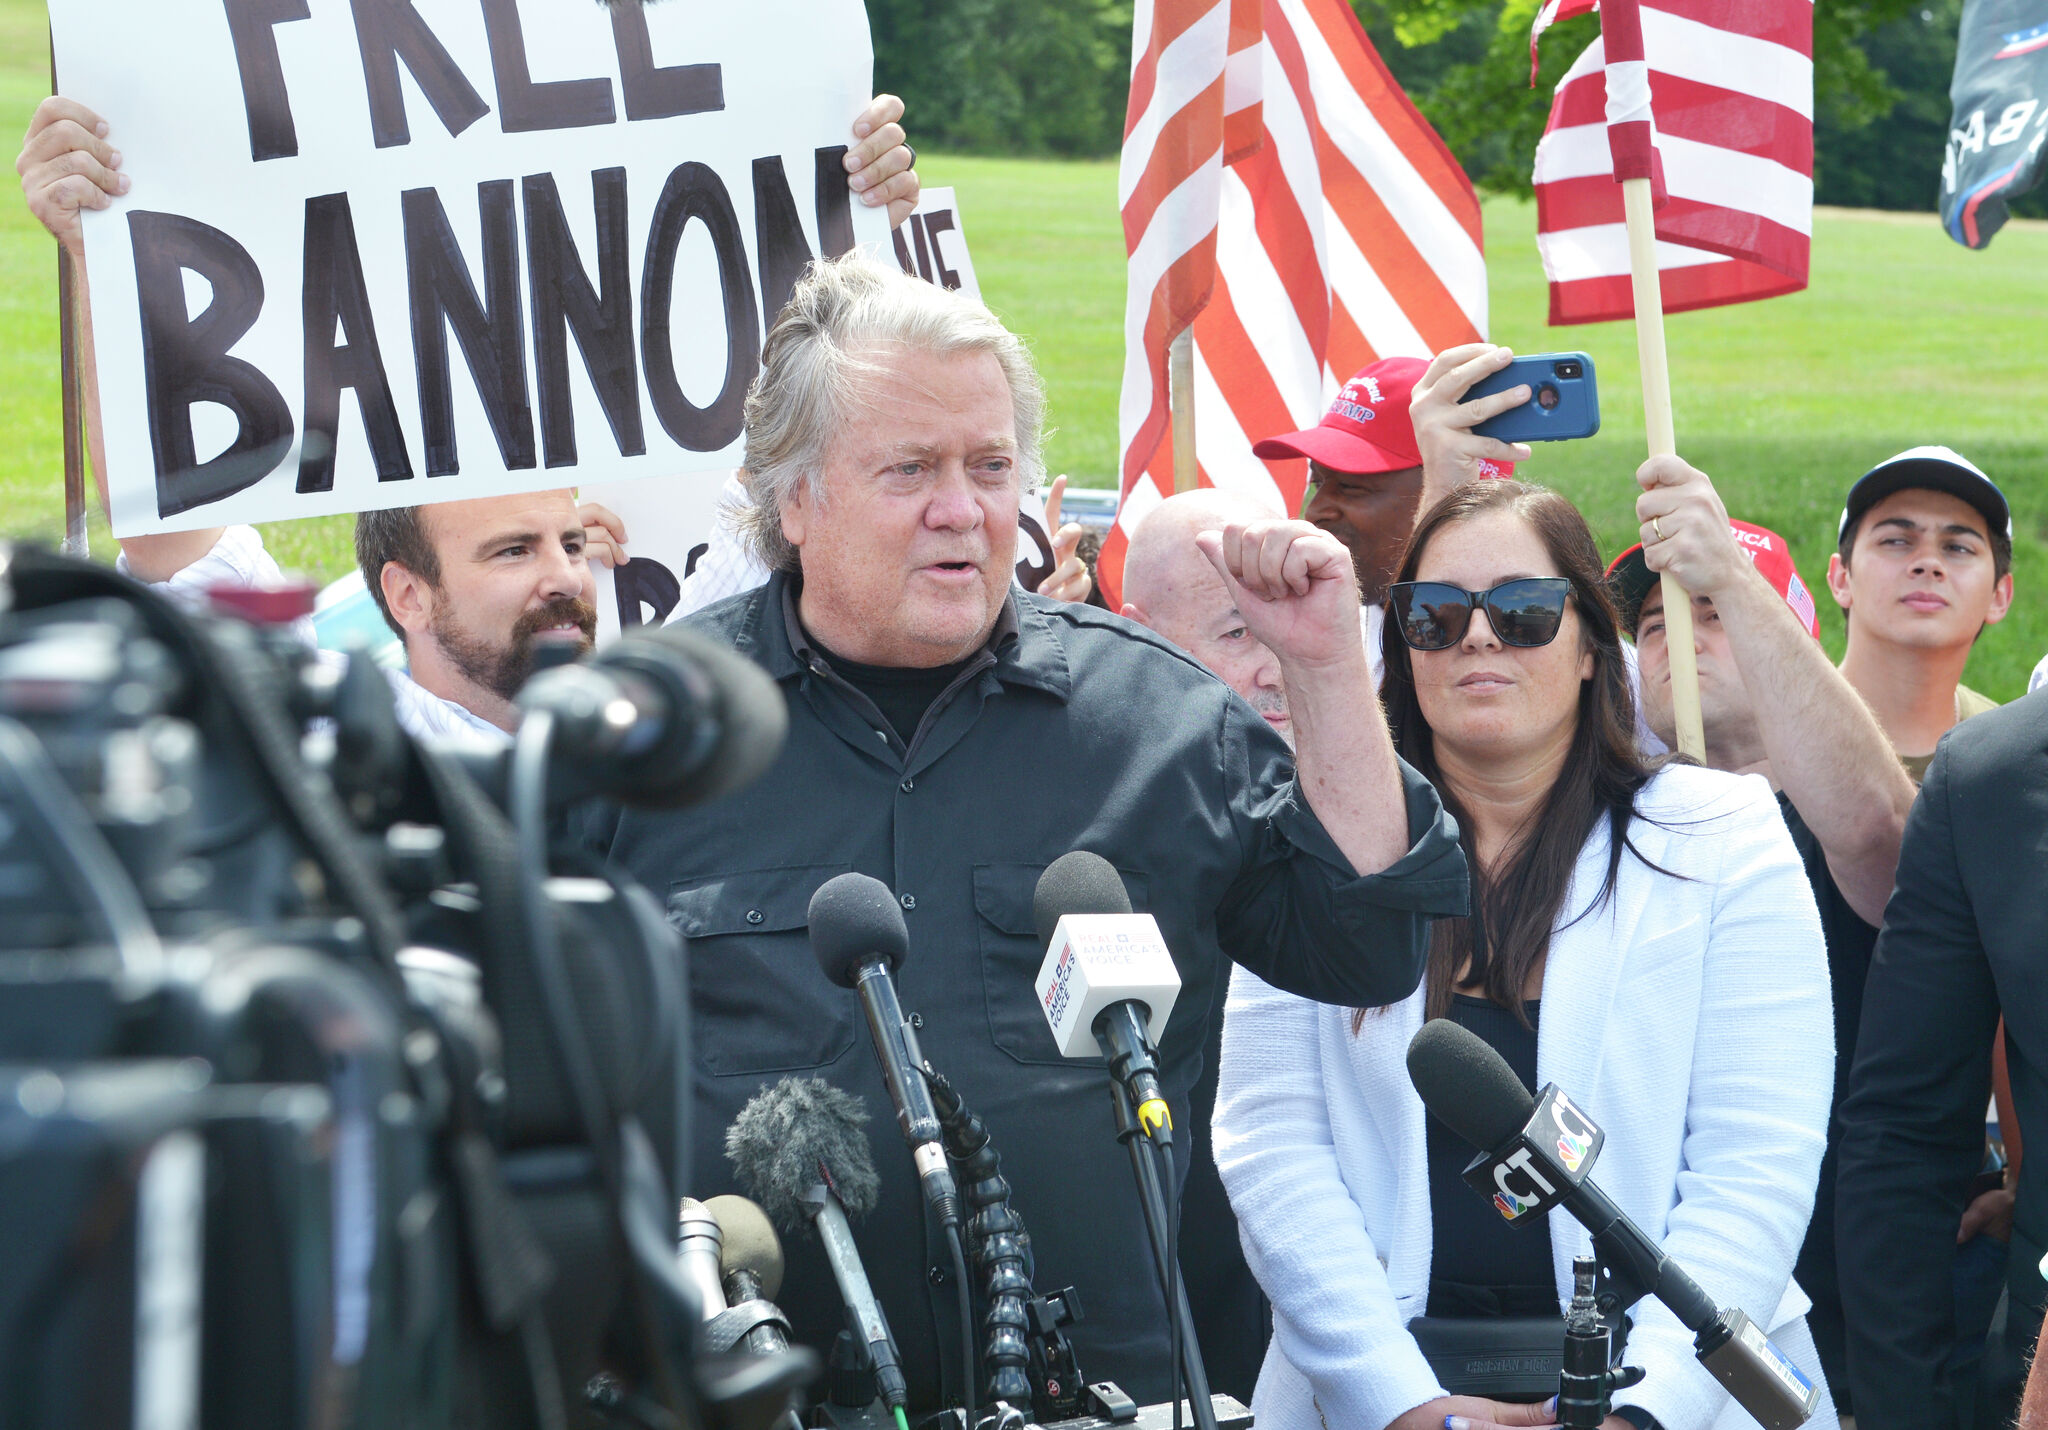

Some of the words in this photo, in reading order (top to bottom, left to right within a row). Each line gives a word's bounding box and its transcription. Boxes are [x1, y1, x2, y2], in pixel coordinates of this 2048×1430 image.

[127, 144, 856, 520] BANNON
[1044, 978, 1058, 1008] REAL
[1049, 952, 1076, 1020] AMERICA'S
[1052, 987, 1070, 1029] VOICE
[1551, 1090, 1597, 1147] CT
[1493, 1146, 1557, 1207] CT
